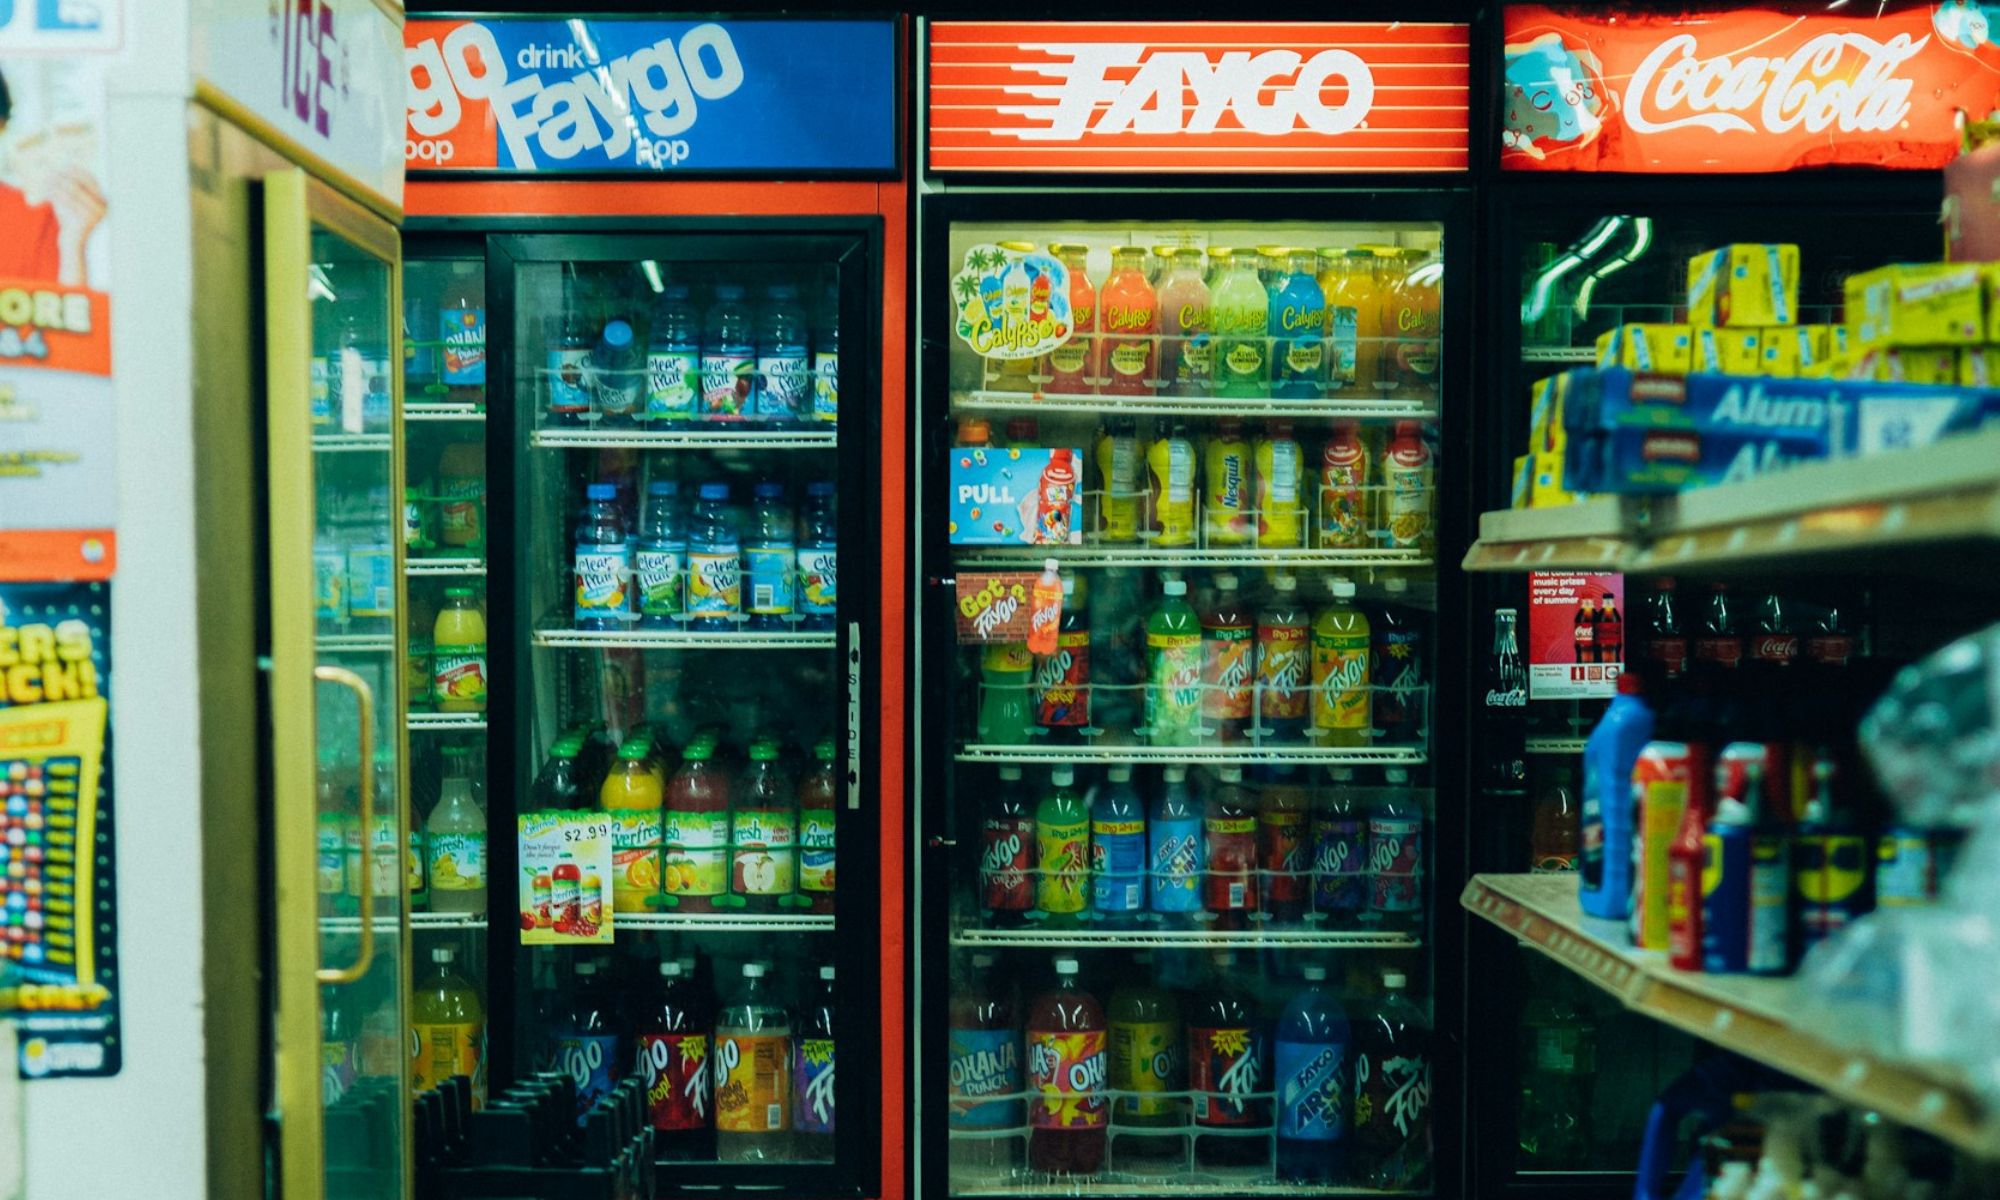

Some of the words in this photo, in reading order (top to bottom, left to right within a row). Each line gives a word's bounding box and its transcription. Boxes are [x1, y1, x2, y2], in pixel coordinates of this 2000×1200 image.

[517, 43, 585, 69] drink
[497, 22, 745, 170] Faygo
[990, 43, 1375, 141] FAYGO
[958, 483, 1016, 504] PULL
[1222, 454, 1241, 509] Nesquik
[960, 578, 1005, 618] Got
[1533, 578, 1559, 587] music
[1560, 578, 1587, 587] prizes
[1533, 588, 1558, 597] every
[1559, 587, 1576, 597] day
[1031, 603, 1060, 633] Faygo
[1544, 597, 1580, 605] summer
[1322, 652, 1366, 709] Faygo
[848, 673, 858, 760] SLIDE
[564, 824, 608, 842] $2.99
[950, 1042, 1018, 1088] OHANA
